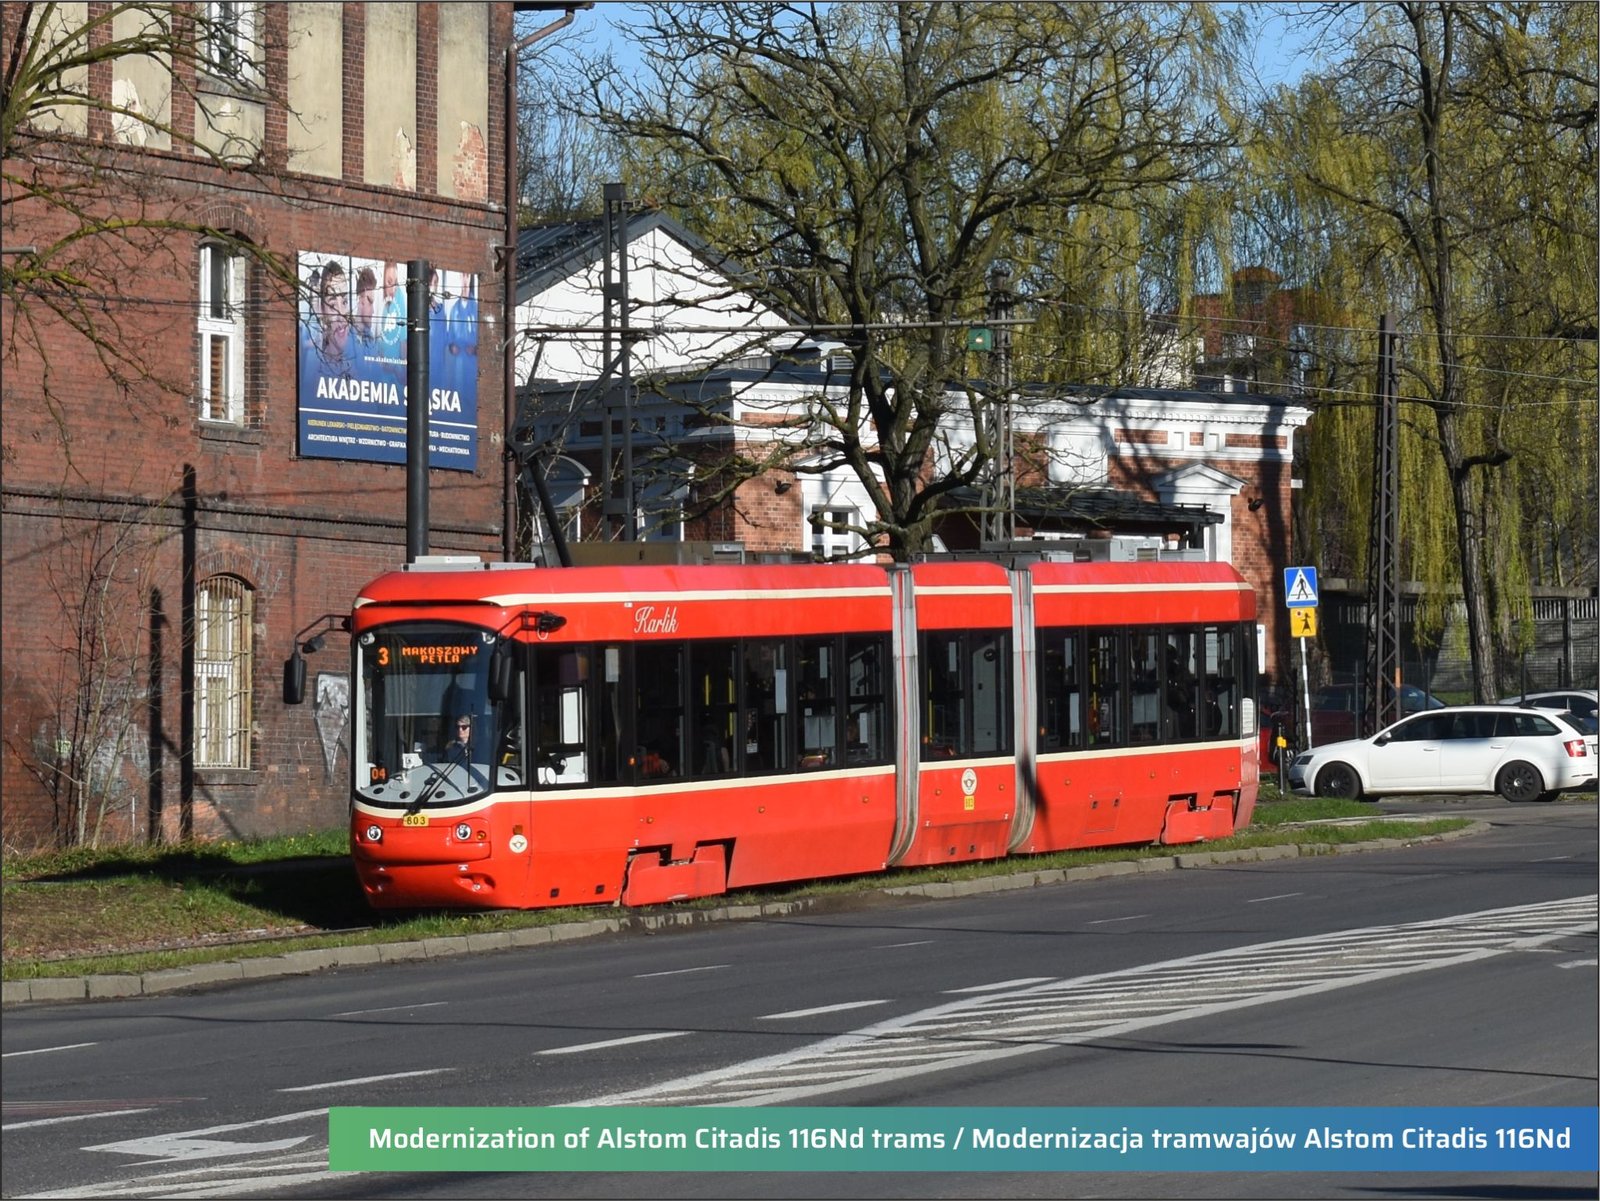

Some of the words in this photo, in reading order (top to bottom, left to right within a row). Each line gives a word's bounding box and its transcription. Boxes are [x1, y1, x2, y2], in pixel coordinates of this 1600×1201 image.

[317, 377, 400, 405] AKADEMIA
[404, 385, 461, 415] SKA
[634, 606, 679, 633] Karlik
[378, 647, 389, 665] 3
[402, 646, 478, 656] MAKOSZOWY
[371, 768, 386, 780] 04
[407, 816, 426, 825] 603
